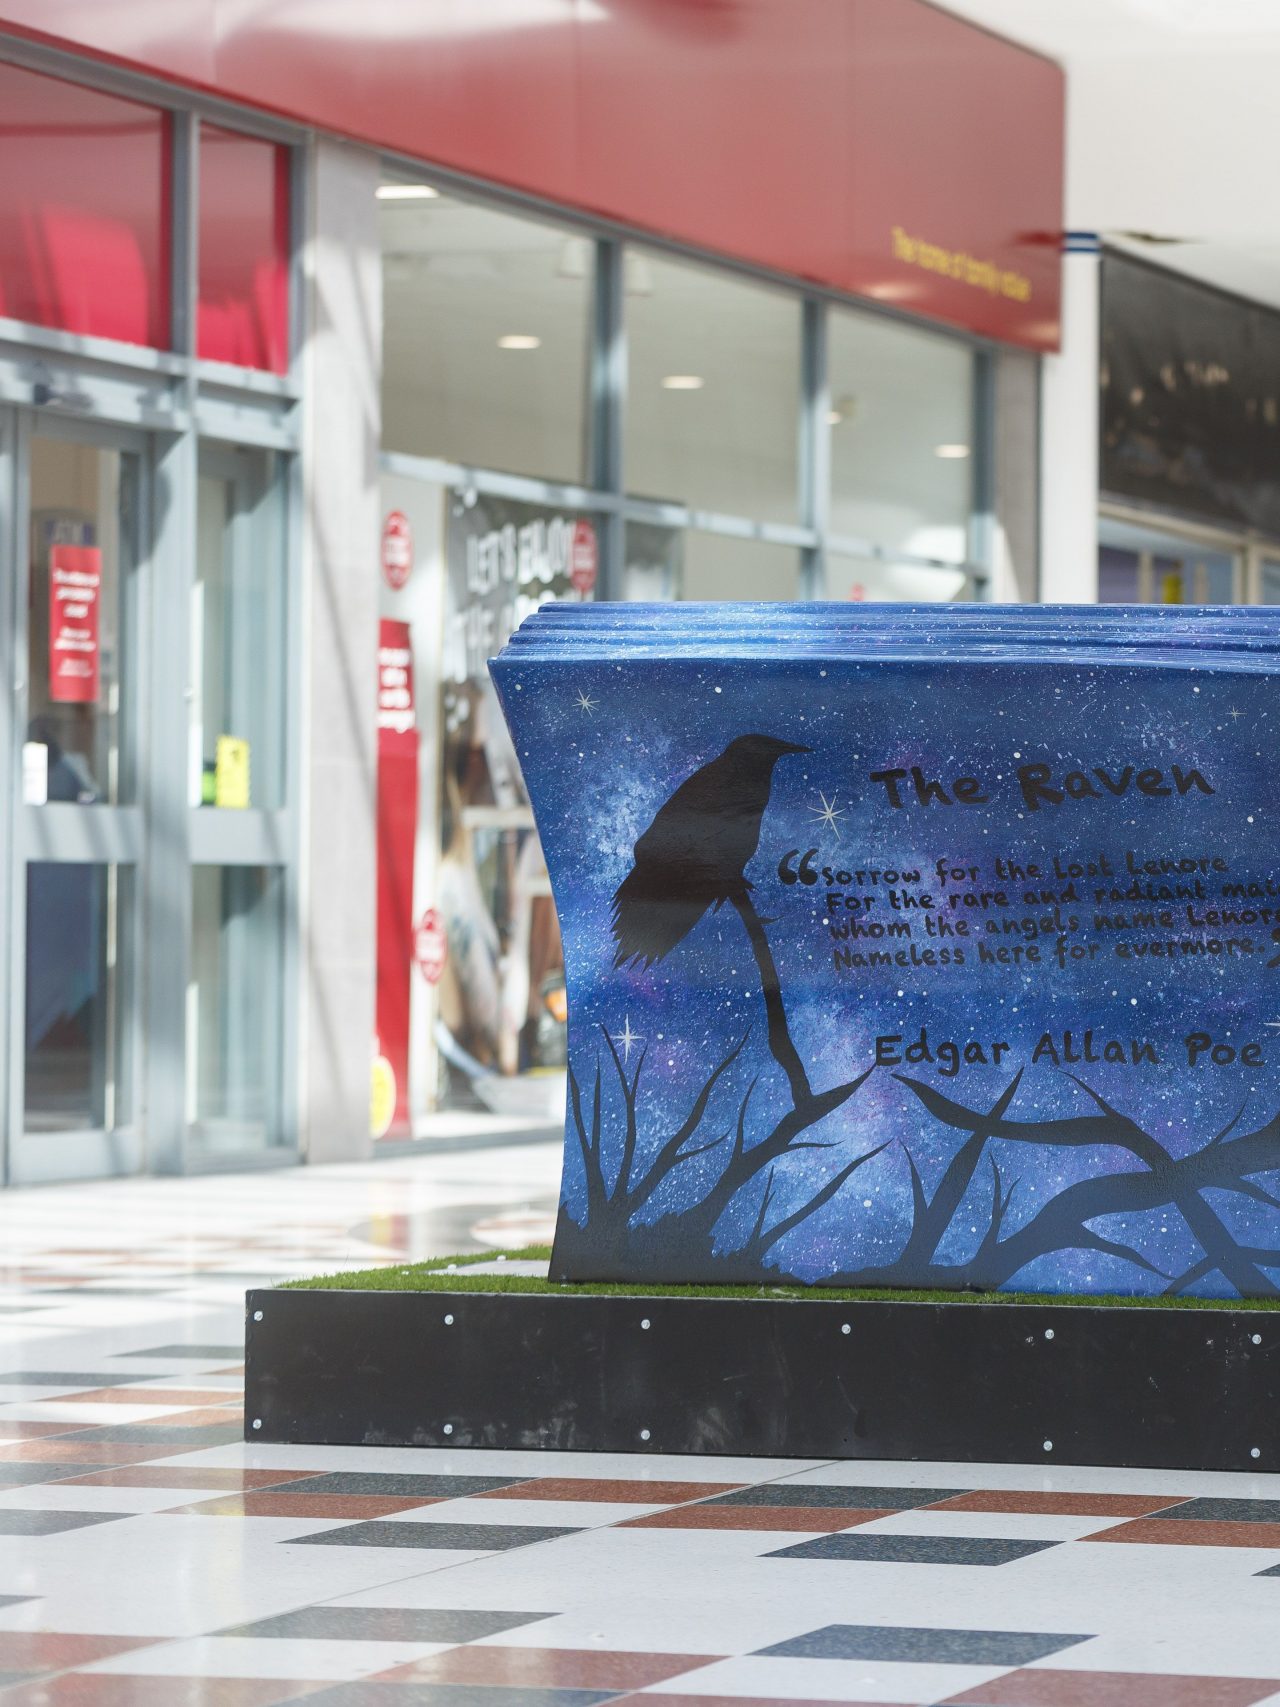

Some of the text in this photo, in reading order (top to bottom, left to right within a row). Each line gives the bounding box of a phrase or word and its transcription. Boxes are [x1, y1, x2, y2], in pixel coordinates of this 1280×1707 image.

[870, 763, 1216, 812] The Raven
[936, 858, 980, 887] for
[996, 857, 1043, 881] the
[1126, 852, 1228, 876] Lenore
[826, 892, 875, 915] For
[889, 889, 935, 910] the
[949, 890, 1009, 910] rare
[1023, 882, 1080, 905] and
[1093, 880, 1206, 901] radiant
[925, 915, 970, 938] the
[985, 906, 1080, 941] angels
[1094, 912, 1175, 931] name
[833, 943, 965, 971] Nameless
[978, 941, 1042, 965] here
[1055, 934, 1099, 969] for
[874, 1027, 1265, 1076] Edgar Allan Poe
